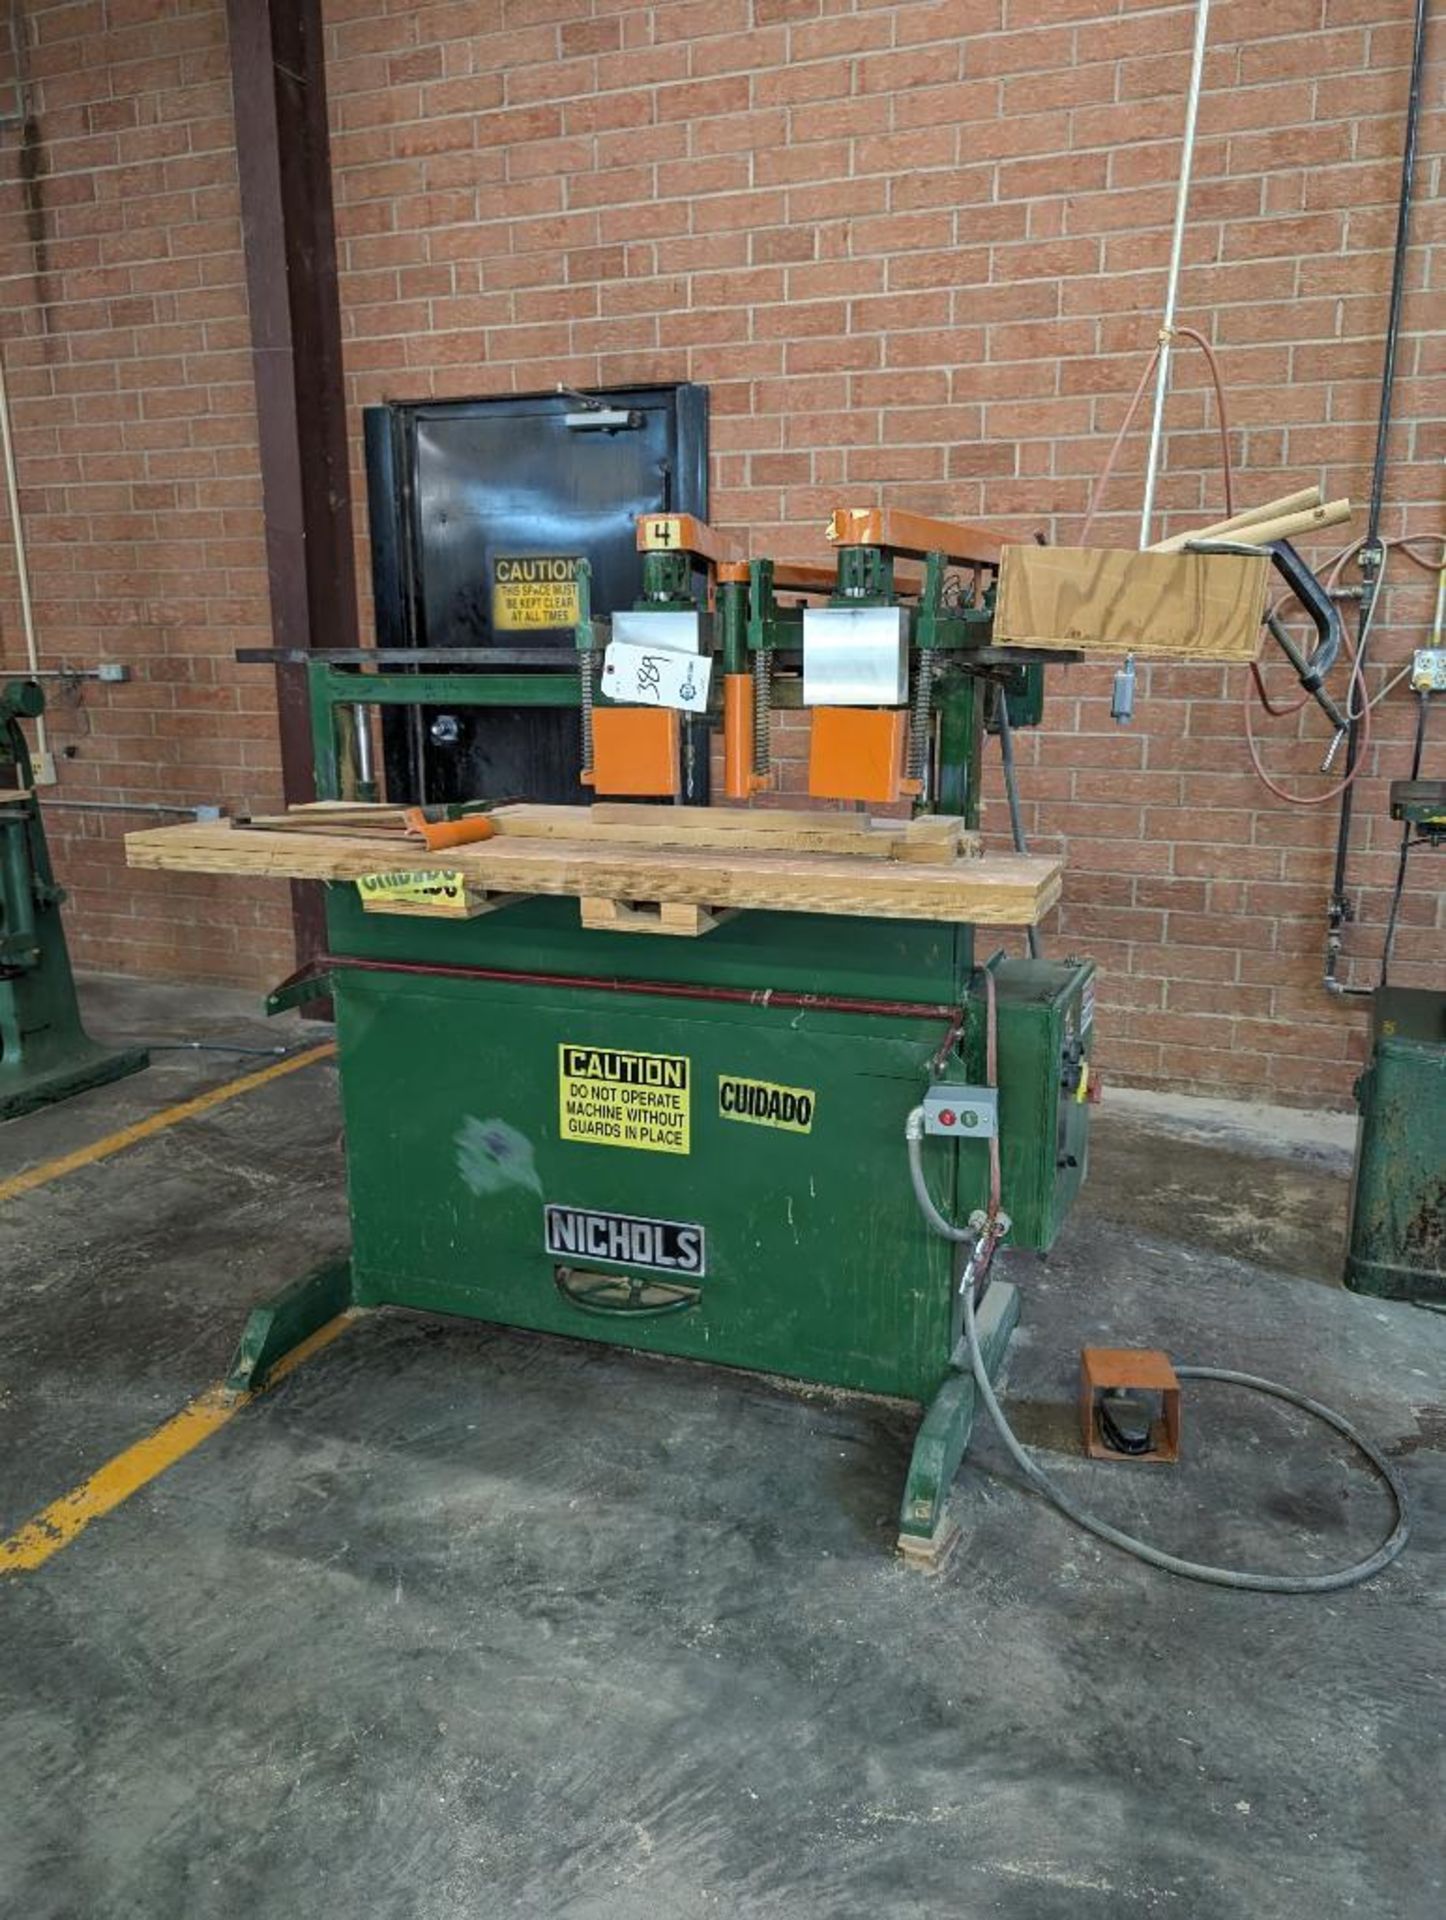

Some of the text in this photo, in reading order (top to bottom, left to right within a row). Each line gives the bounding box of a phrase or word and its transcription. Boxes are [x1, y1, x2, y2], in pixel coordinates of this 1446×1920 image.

[655, 522, 670, 547] 4
[497, 560, 577, 581] CAUTION
[501, 584, 577, 596] THIS SPACE MUST
[506, 597, 574, 609] BE KEPT CLEAR
[511, 610, 568, 621] AT ALL TIMES
[570, 1050, 682, 1088] CAUTION
[570, 1083, 681, 1110] DO NOT OPERATE
[721, 1082, 811, 1126] CUIDADO
[567, 1100, 685, 1128] MACHINE WITHOUT
[569, 1118, 682, 1146] GUARDS IN PLACE
[551, 1211, 699, 1269] NICHOLS
